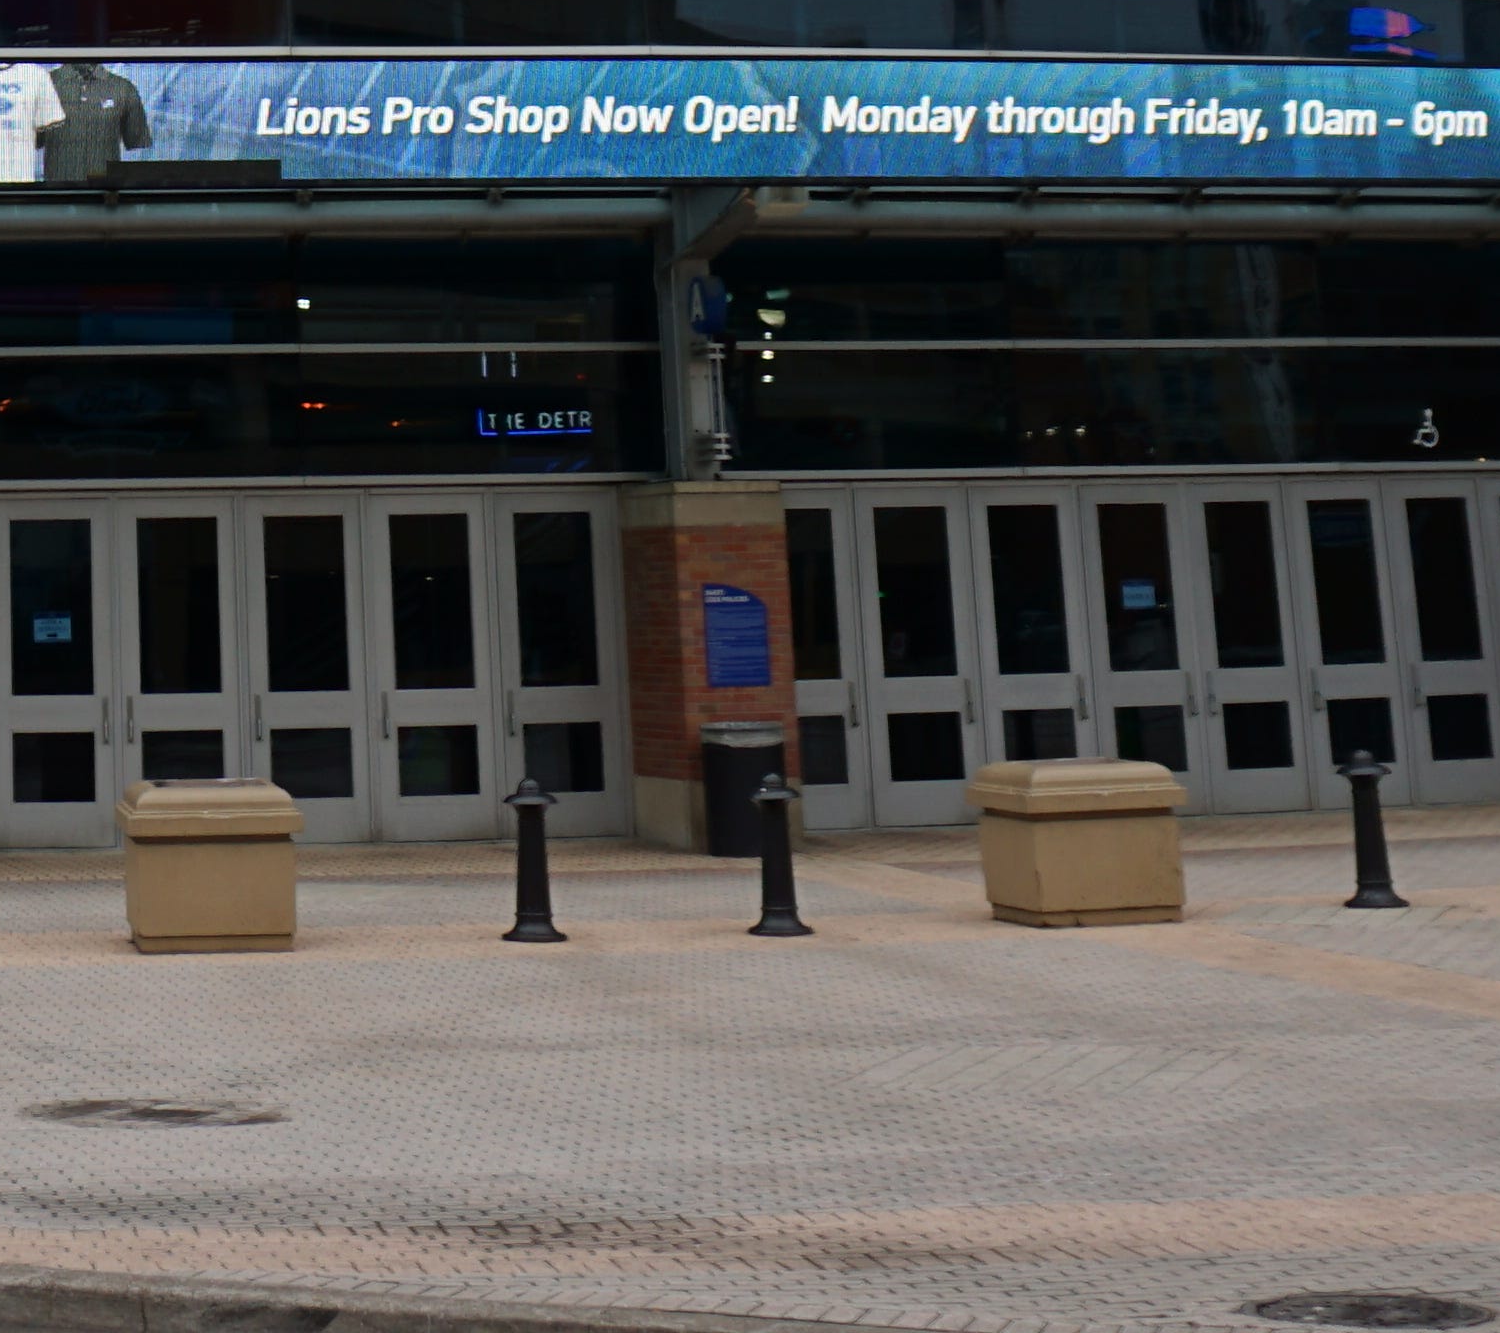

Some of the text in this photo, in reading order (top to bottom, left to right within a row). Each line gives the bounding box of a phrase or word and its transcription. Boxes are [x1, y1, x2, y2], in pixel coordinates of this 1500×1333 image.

[256, 96, 371, 136] Lions
[382, 96, 455, 135] Pro
[463, 94, 570, 143] Shop
[581, 95, 673, 134] Now
[683, 94, 799, 143] Open!
[821, 96, 976, 143] Monday
[985, 97, 1135, 144] through
[1144, 99, 1269, 143] Friday,
[1282, 101, 1378, 137] 10am
[1411, 100, 1489, 146] 6pm
